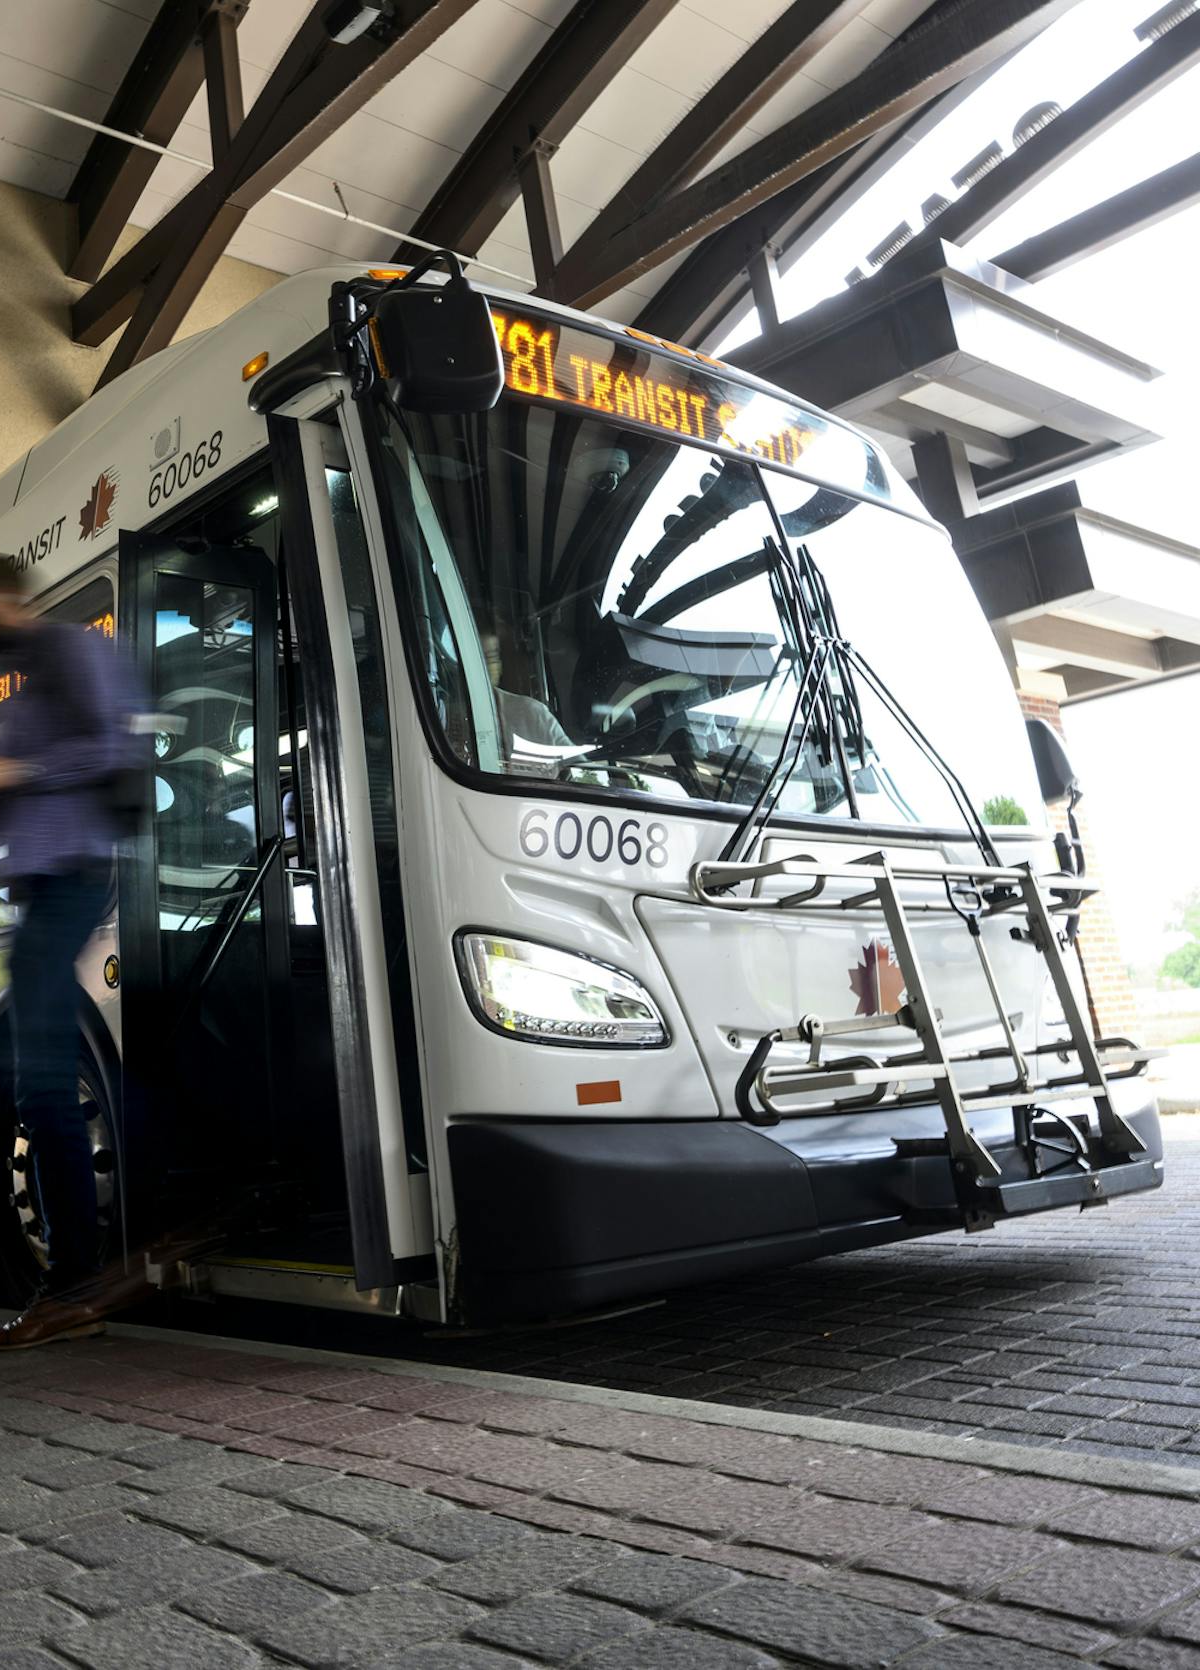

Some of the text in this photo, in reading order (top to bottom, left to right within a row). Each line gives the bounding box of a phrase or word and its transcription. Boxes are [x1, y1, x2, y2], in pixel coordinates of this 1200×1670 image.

[569, 354, 710, 439] TRANSIT
[148, 430, 224, 508] 60068
[6, 515, 67, 575] RANSIT
[519, 808, 669, 869] 60068
